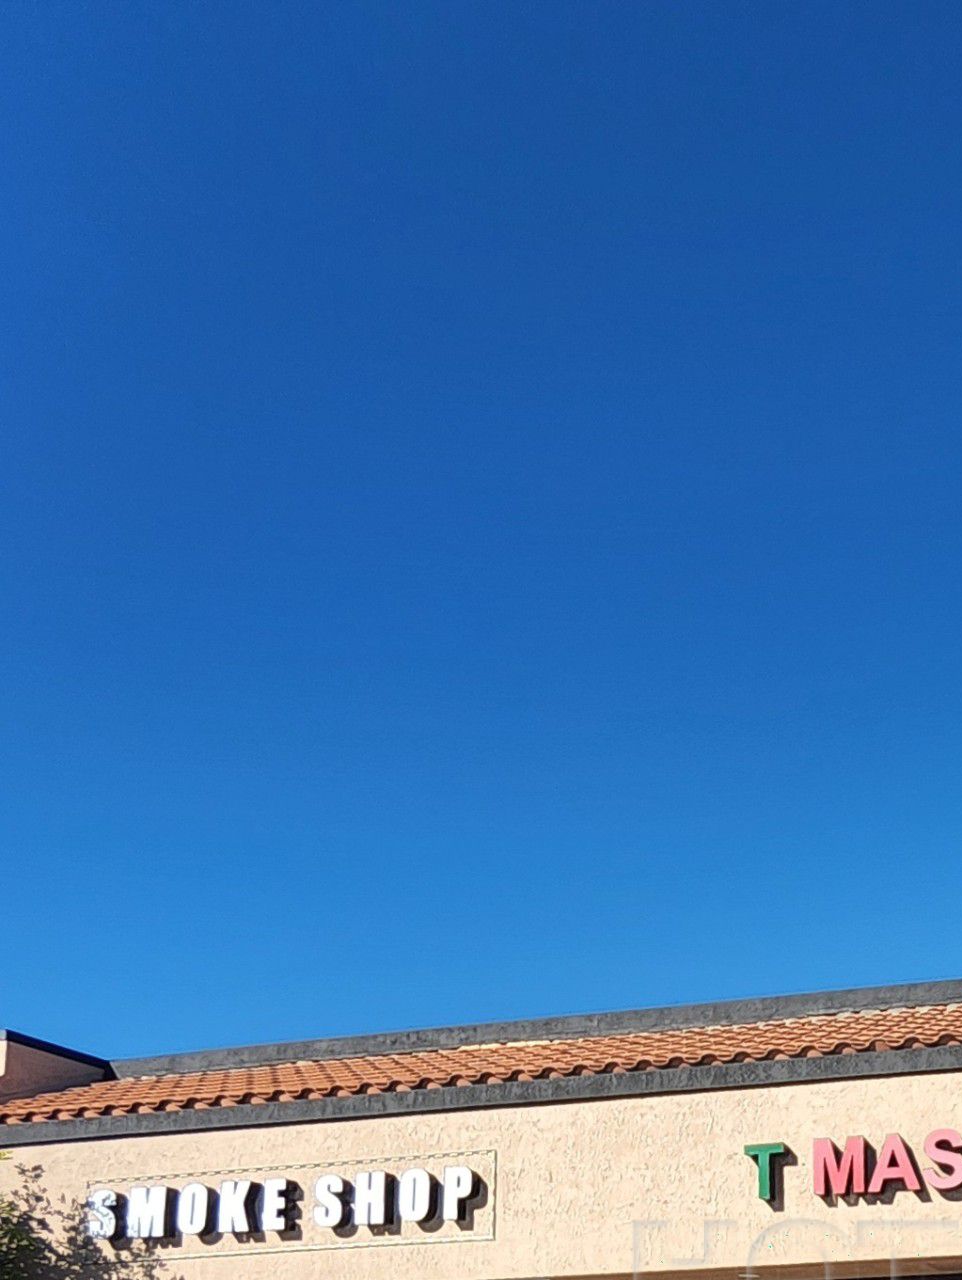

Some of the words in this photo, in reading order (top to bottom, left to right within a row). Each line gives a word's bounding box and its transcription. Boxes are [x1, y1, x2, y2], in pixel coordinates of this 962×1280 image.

[89, 1177, 288, 1240] SMOKE
[313, 1165, 474, 1227] SHOP
[744, 1143, 785, 1200] T
